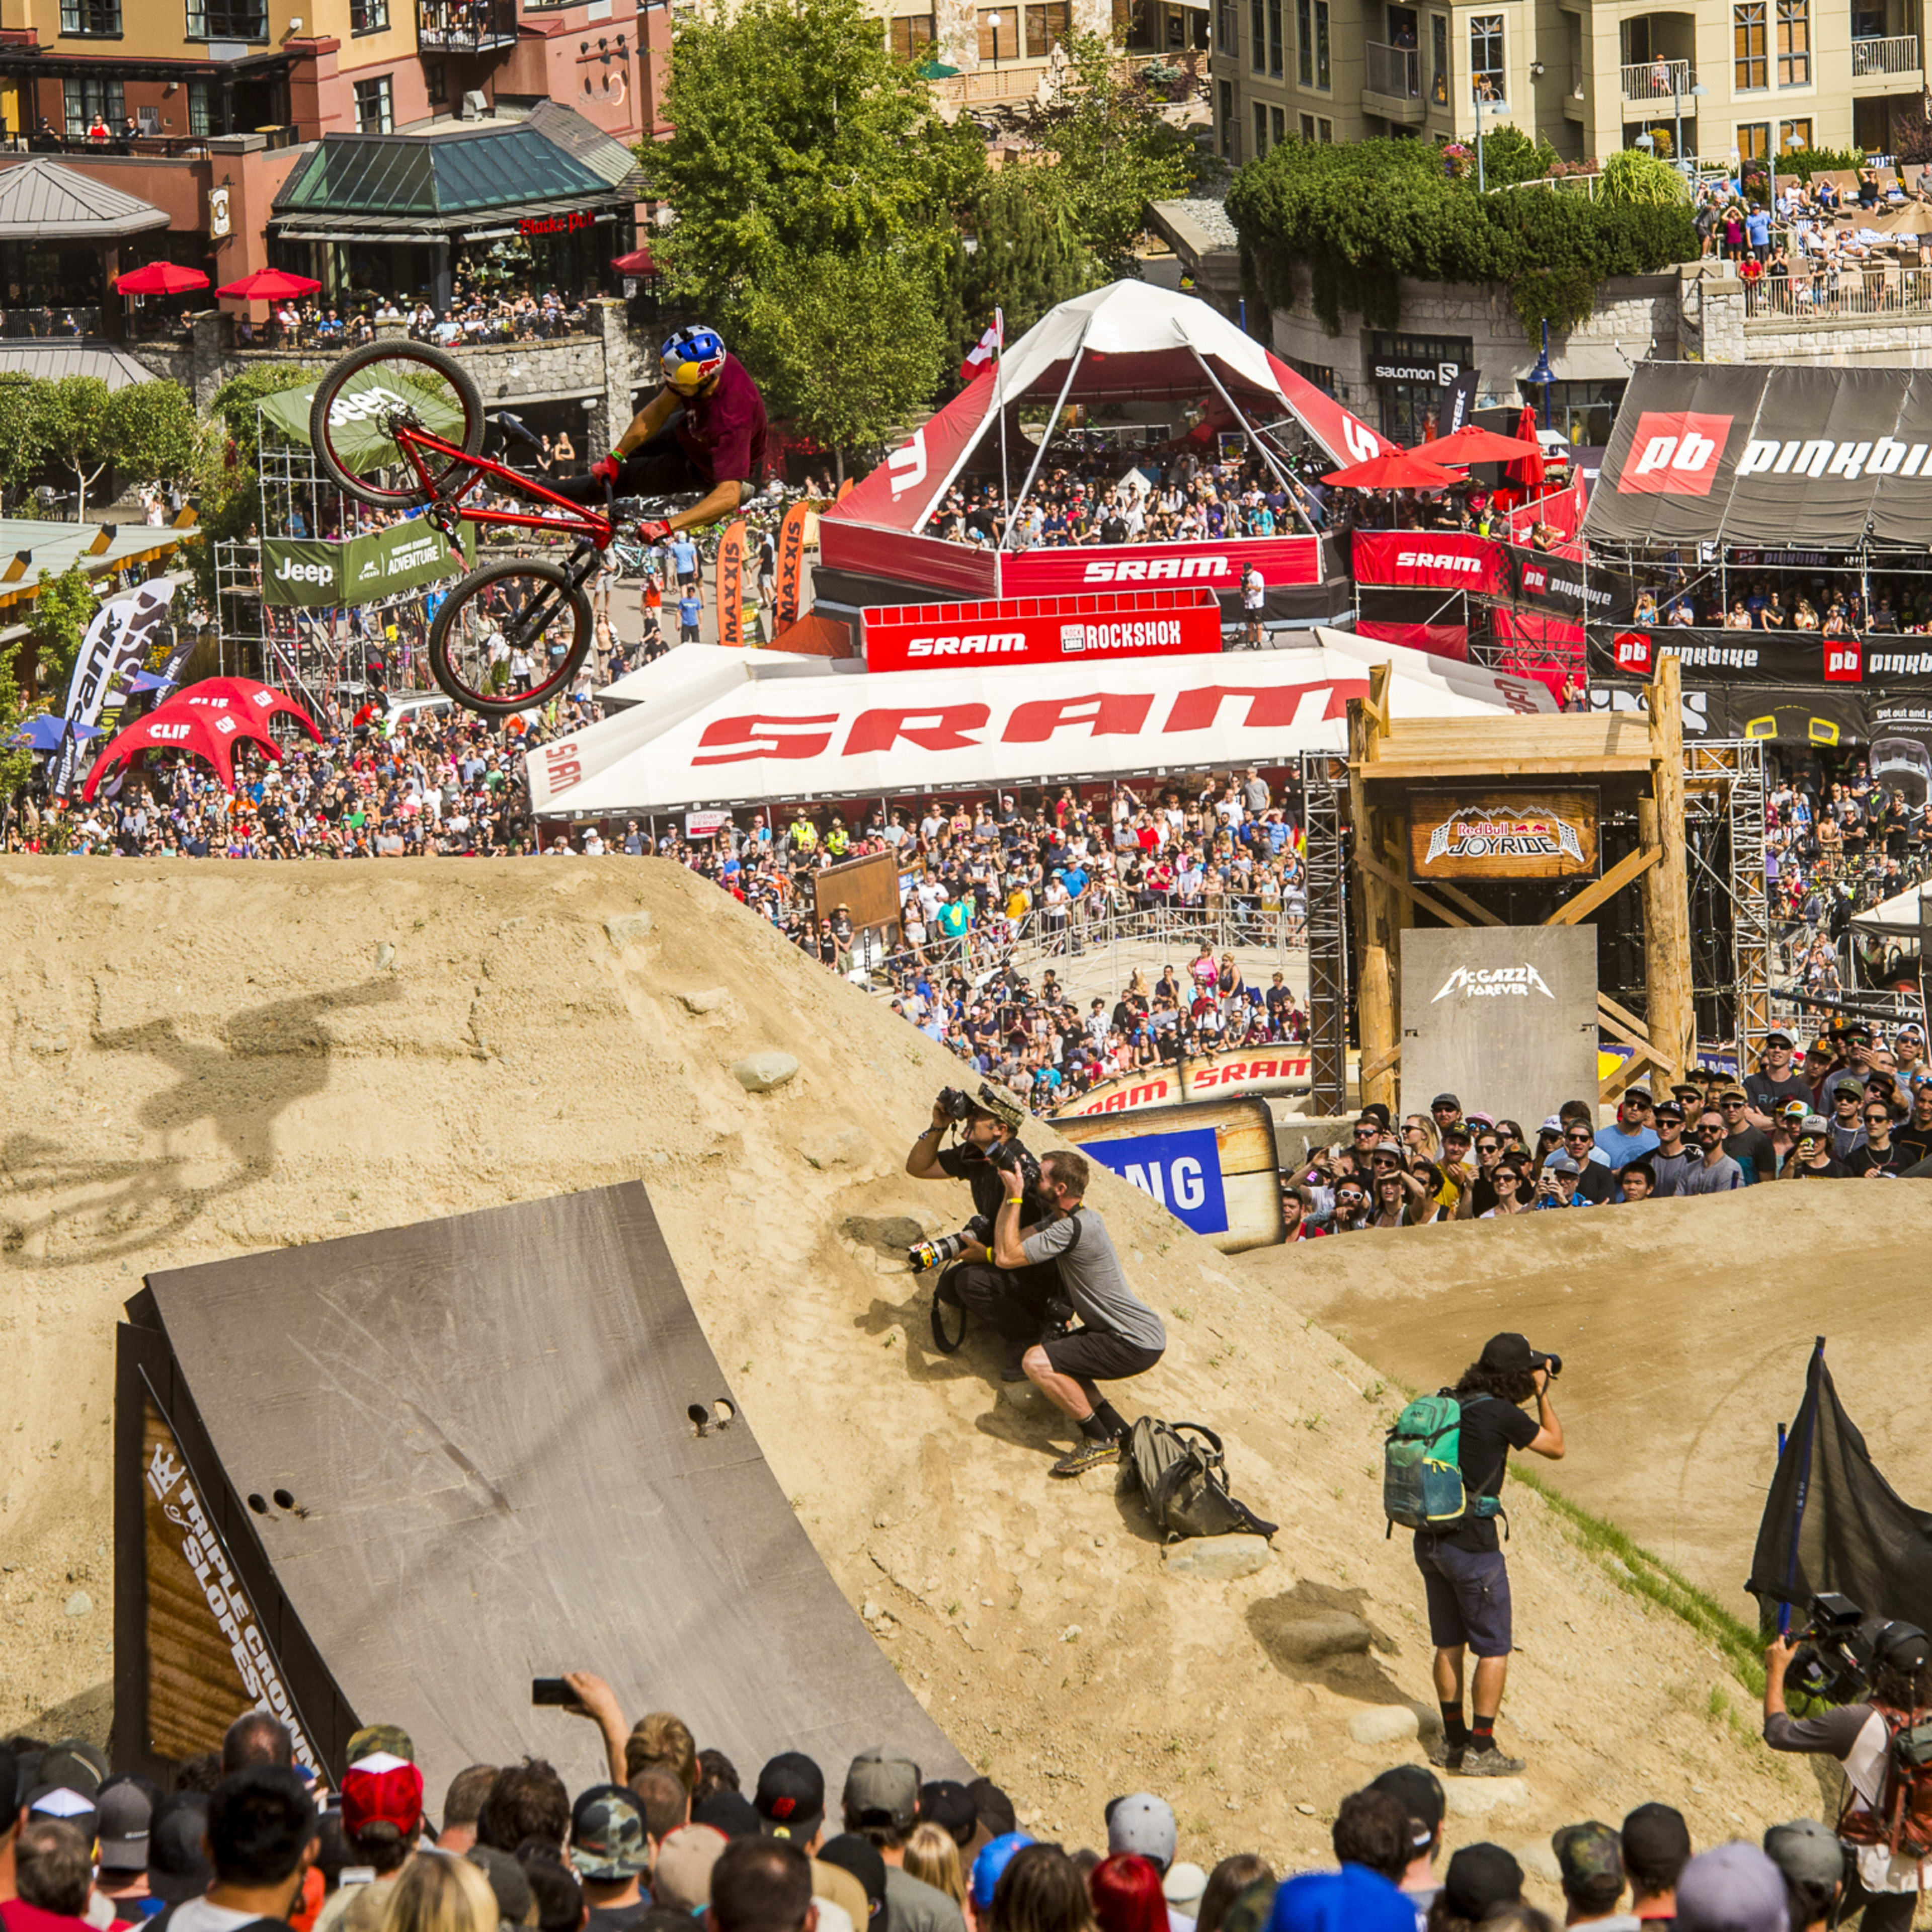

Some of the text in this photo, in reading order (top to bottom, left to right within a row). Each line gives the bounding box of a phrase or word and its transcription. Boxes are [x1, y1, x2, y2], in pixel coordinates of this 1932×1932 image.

[518, 211, 596, 235] Blacks Pub
[1375, 365, 1435, 381] salomon
[1635, 432, 1932, 479] pb pinkbi
[275, 556, 333, 587] Jeep
[387, 545, 440, 576] ADVENTURE
[780, 521, 801, 623] MAXXIS
[1083, 555, 1228, 583] SRAM
[1396, 552, 1482, 573] SRAM
[725, 541, 739, 643] MAXXIS
[1550, 577, 1613, 606] pinkbike
[907, 633, 1027, 657] SRAM
[1086, 620, 1181, 649] ROCKSHOX
[1619, 643, 1647, 664] pb
[1829, 650, 1858, 671] pb
[691, 678, 1371, 766] SRAM
[1877, 708, 1892, 719] get
[1893, 708, 1907, 718] out
[1908, 708, 1925, 718] and
[149, 723, 191, 740] CLIF
[1458, 822, 1508, 836] Red Bull
[1447, 836, 1564, 856] JOYRIDE
[1193, 1059, 1312, 1090] SRAM
[179, 1480, 322, 1780] TRIPLE CROWN
